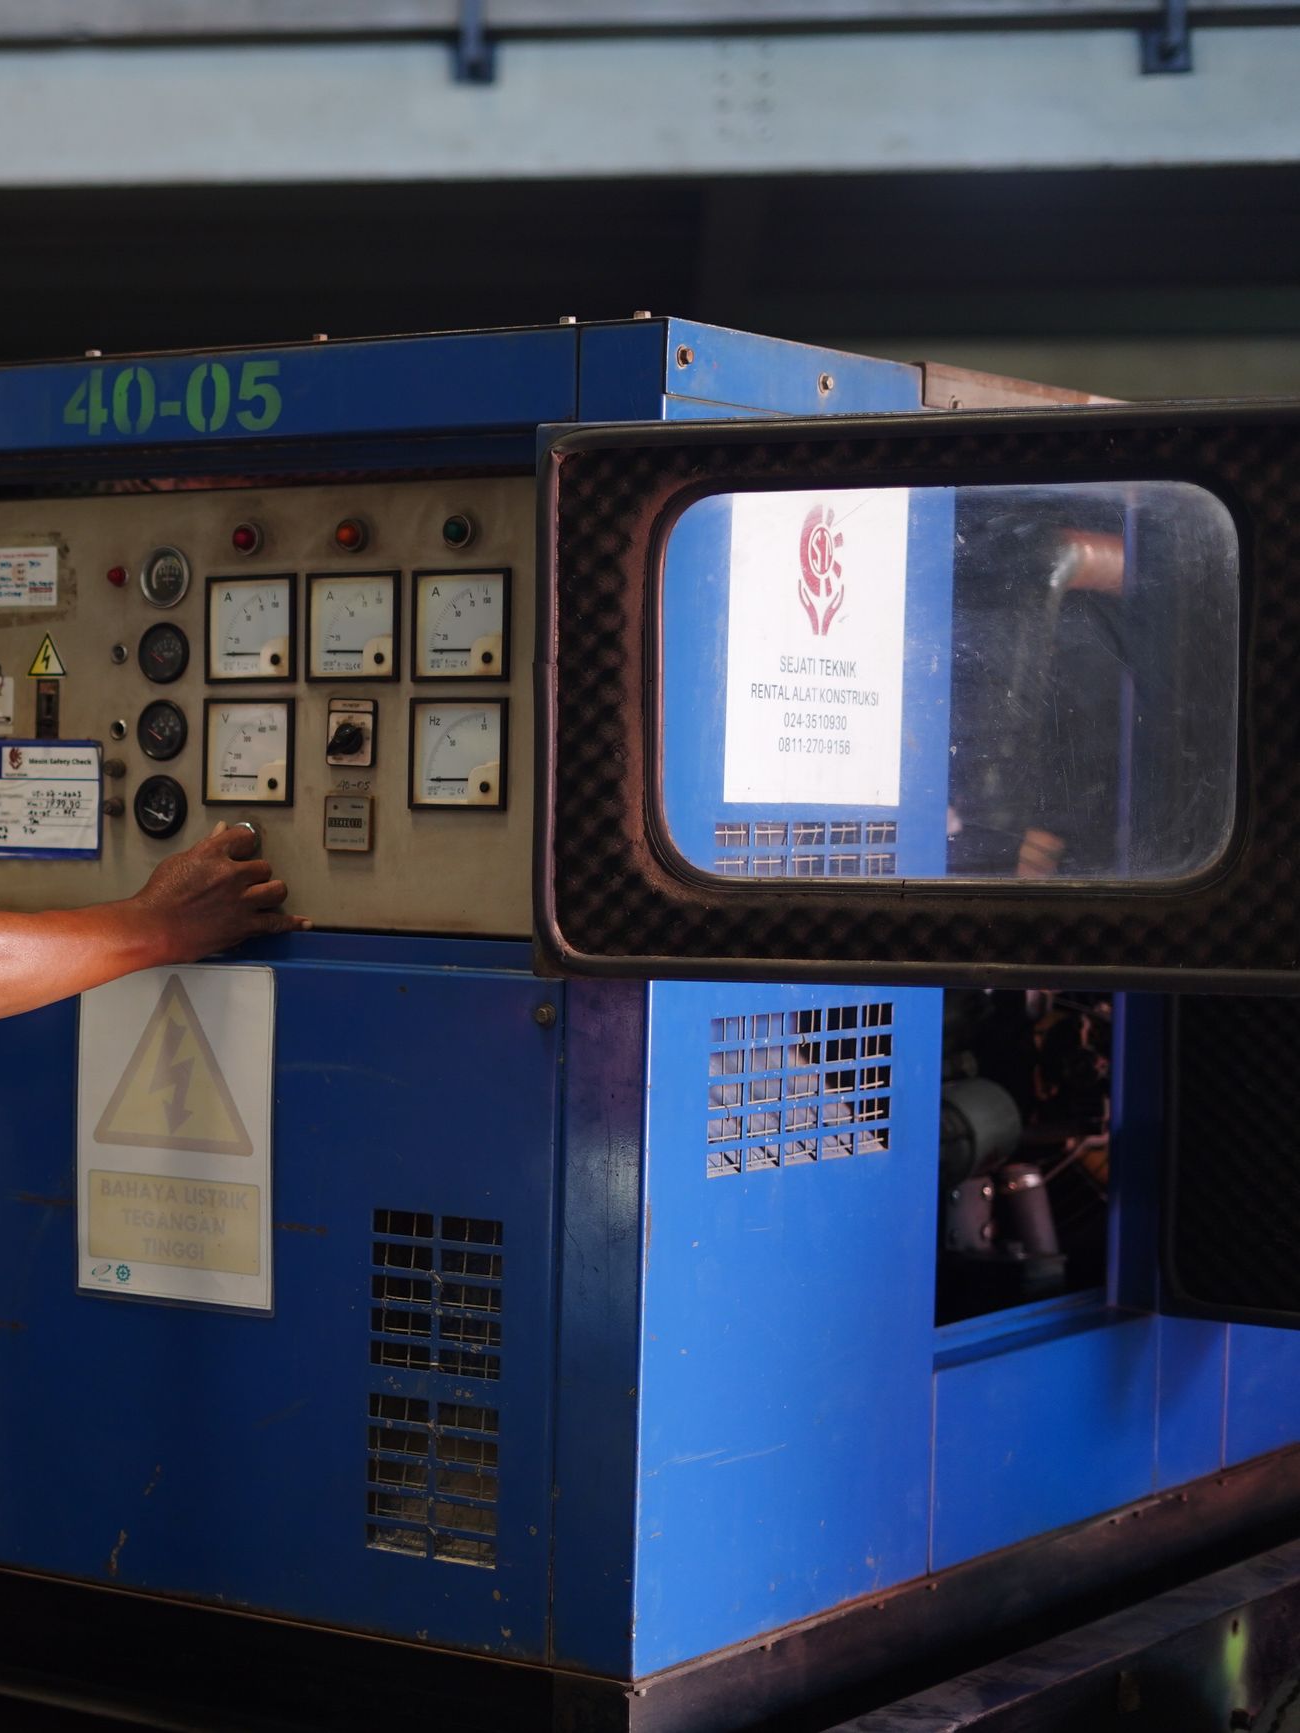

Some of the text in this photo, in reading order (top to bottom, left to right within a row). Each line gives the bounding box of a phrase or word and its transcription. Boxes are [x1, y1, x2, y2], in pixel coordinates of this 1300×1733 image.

[63, 360, 282, 436] 40-05
[224, 592, 232, 601] A
[326, 591, 334, 600] A
[431, 586, 440, 597] A
[780, 655, 857, 679] SEJATI TEKNIK
[751, 683, 879, 706] RENTAL ALAT KONSTRUKSI
[222, 713, 230, 724] V
[429, 715, 441, 726] Hz
[783, 712, 847, 730] 024-3510930
[778, 736, 851, 755] 0811-270-9156
[71, 758, 92, 766] Check
[101, 1178, 248, 1210] BAHAYA LISTRIK
[121, 1208, 226, 1236] TEGANGAN
[141, 1237, 205, 1261] TINGGI
